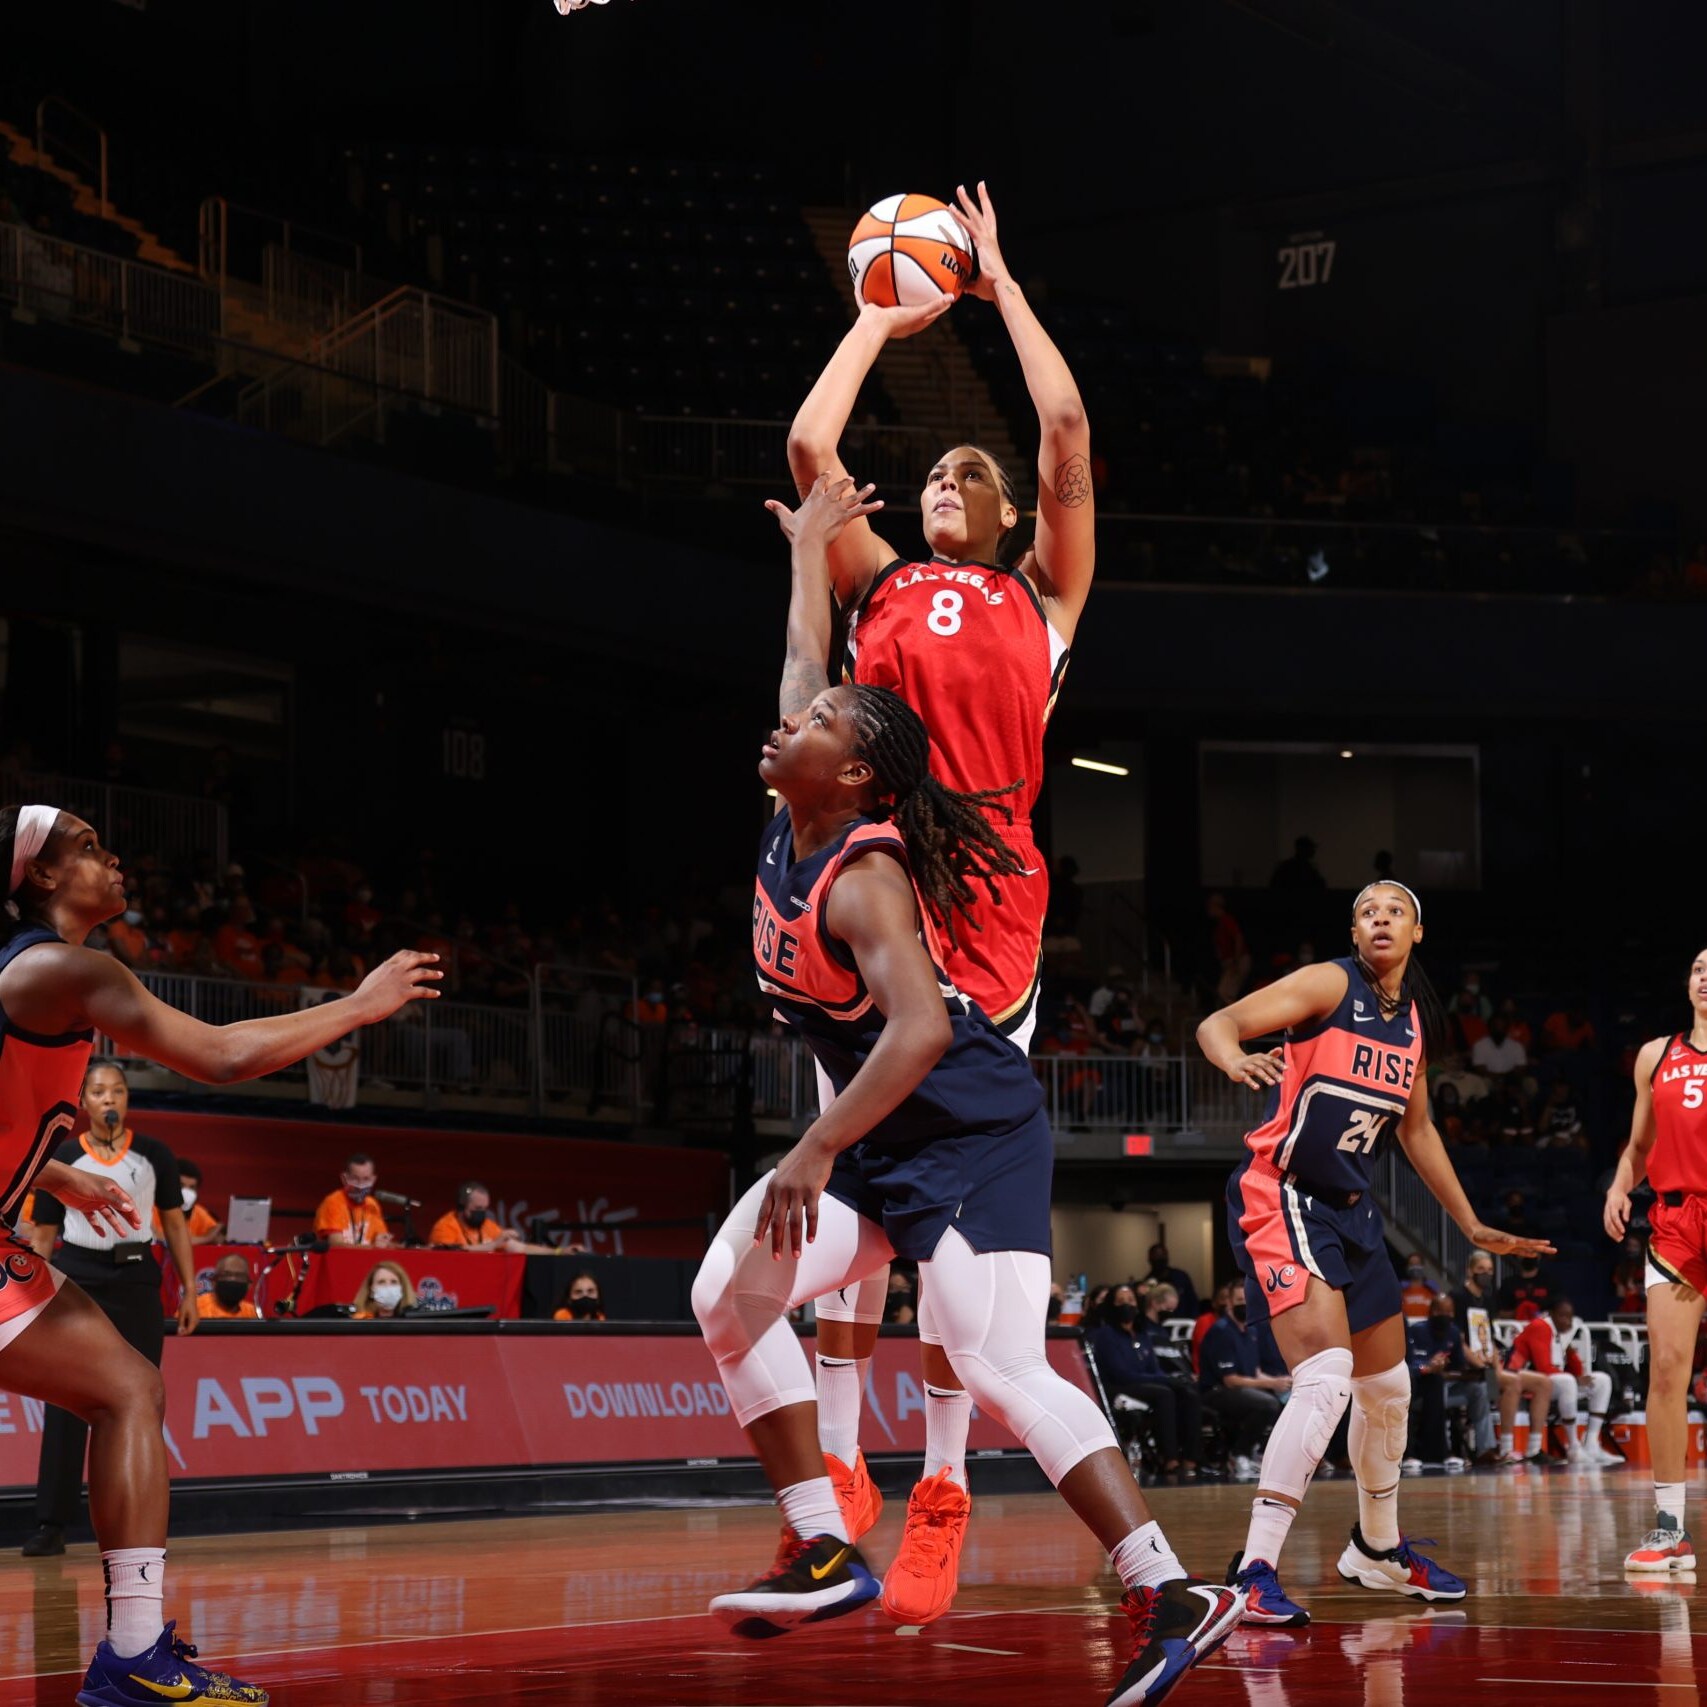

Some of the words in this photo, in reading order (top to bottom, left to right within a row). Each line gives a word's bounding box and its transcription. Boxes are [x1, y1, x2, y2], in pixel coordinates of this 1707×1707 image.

[1277, 240, 1337, 289] 207
[927, 589, 964, 637] 8
[442, 728, 487, 780] 108
[1351, 1043, 1415, 1091] RISE
[1662, 1064, 1691, 1084] LAS
[1682, 1079, 1706, 1110] 5
[1338, 1109, 1390, 1155] 24
[192, 1377, 346, 1439] APP
[359, 1385, 467, 1424] TODAY
[563, 1382, 731, 1419] DOWNLOAD
